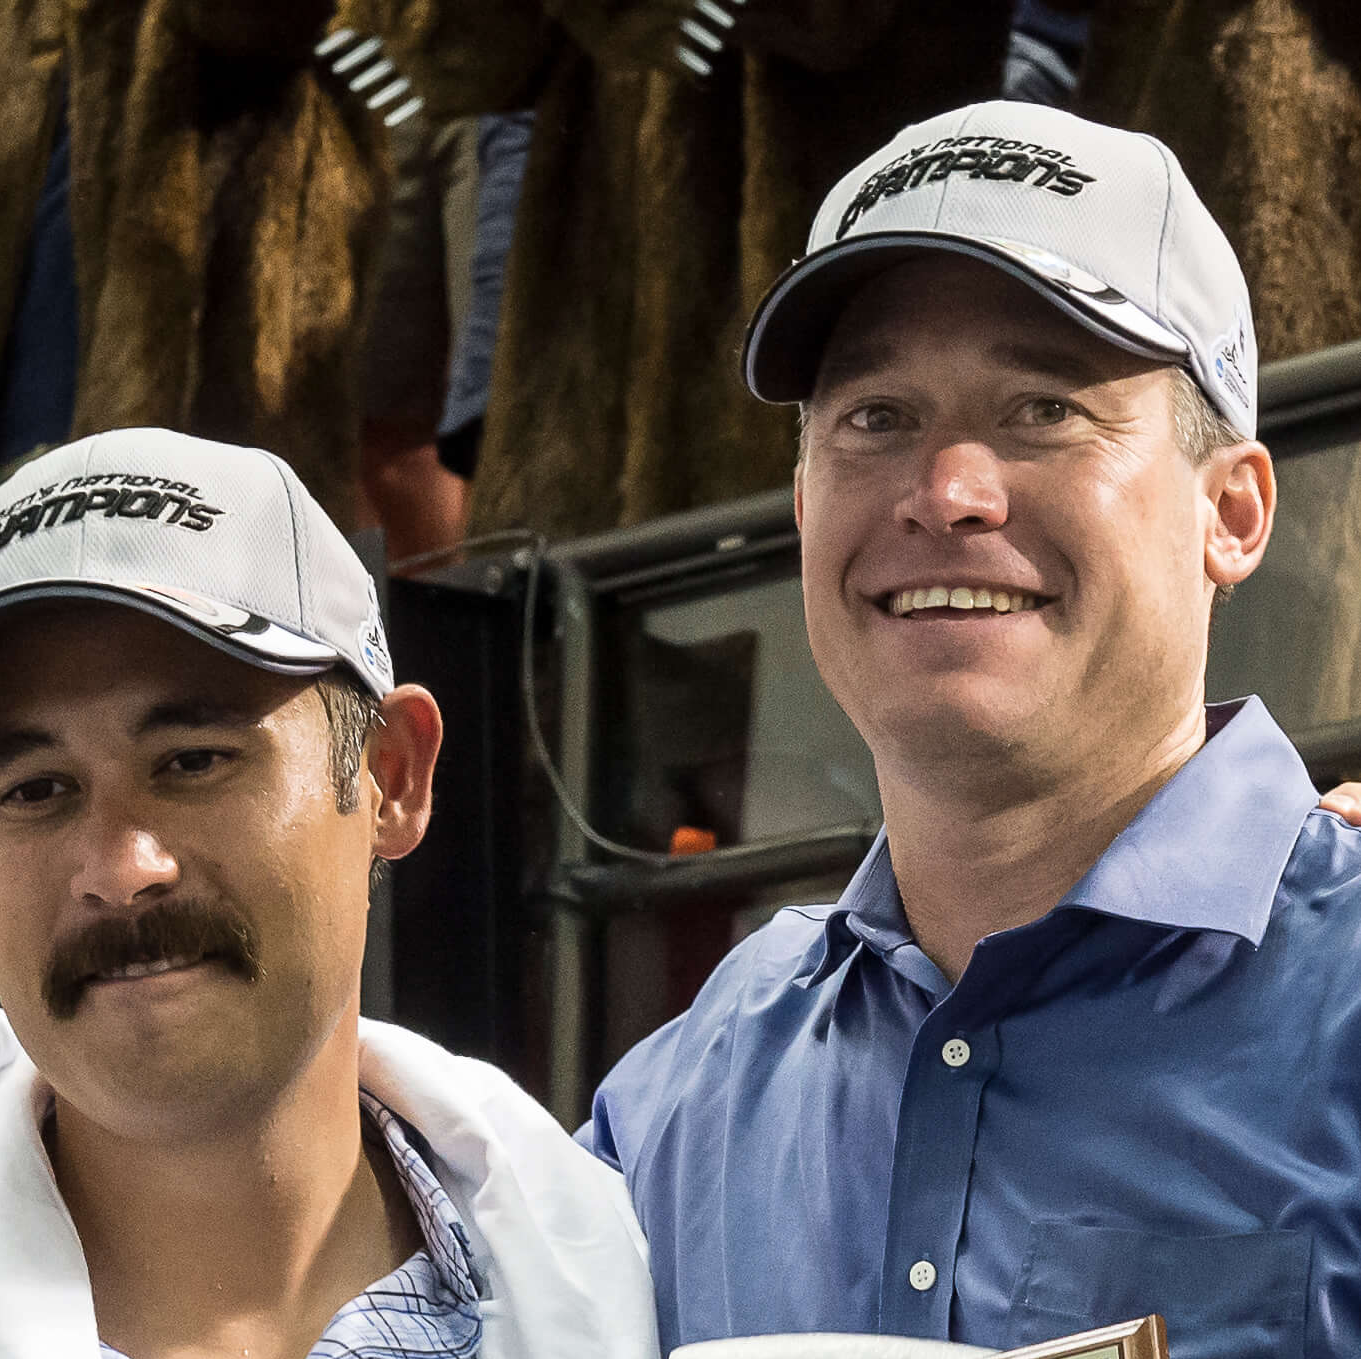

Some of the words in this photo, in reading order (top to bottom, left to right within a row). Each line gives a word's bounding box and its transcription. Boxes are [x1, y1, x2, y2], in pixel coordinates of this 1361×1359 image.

[930, 135, 1076, 168] NATIONAL
[835, 148, 1098, 241] CHAMPIONS
[60, 473, 205, 500] NATIONAL
